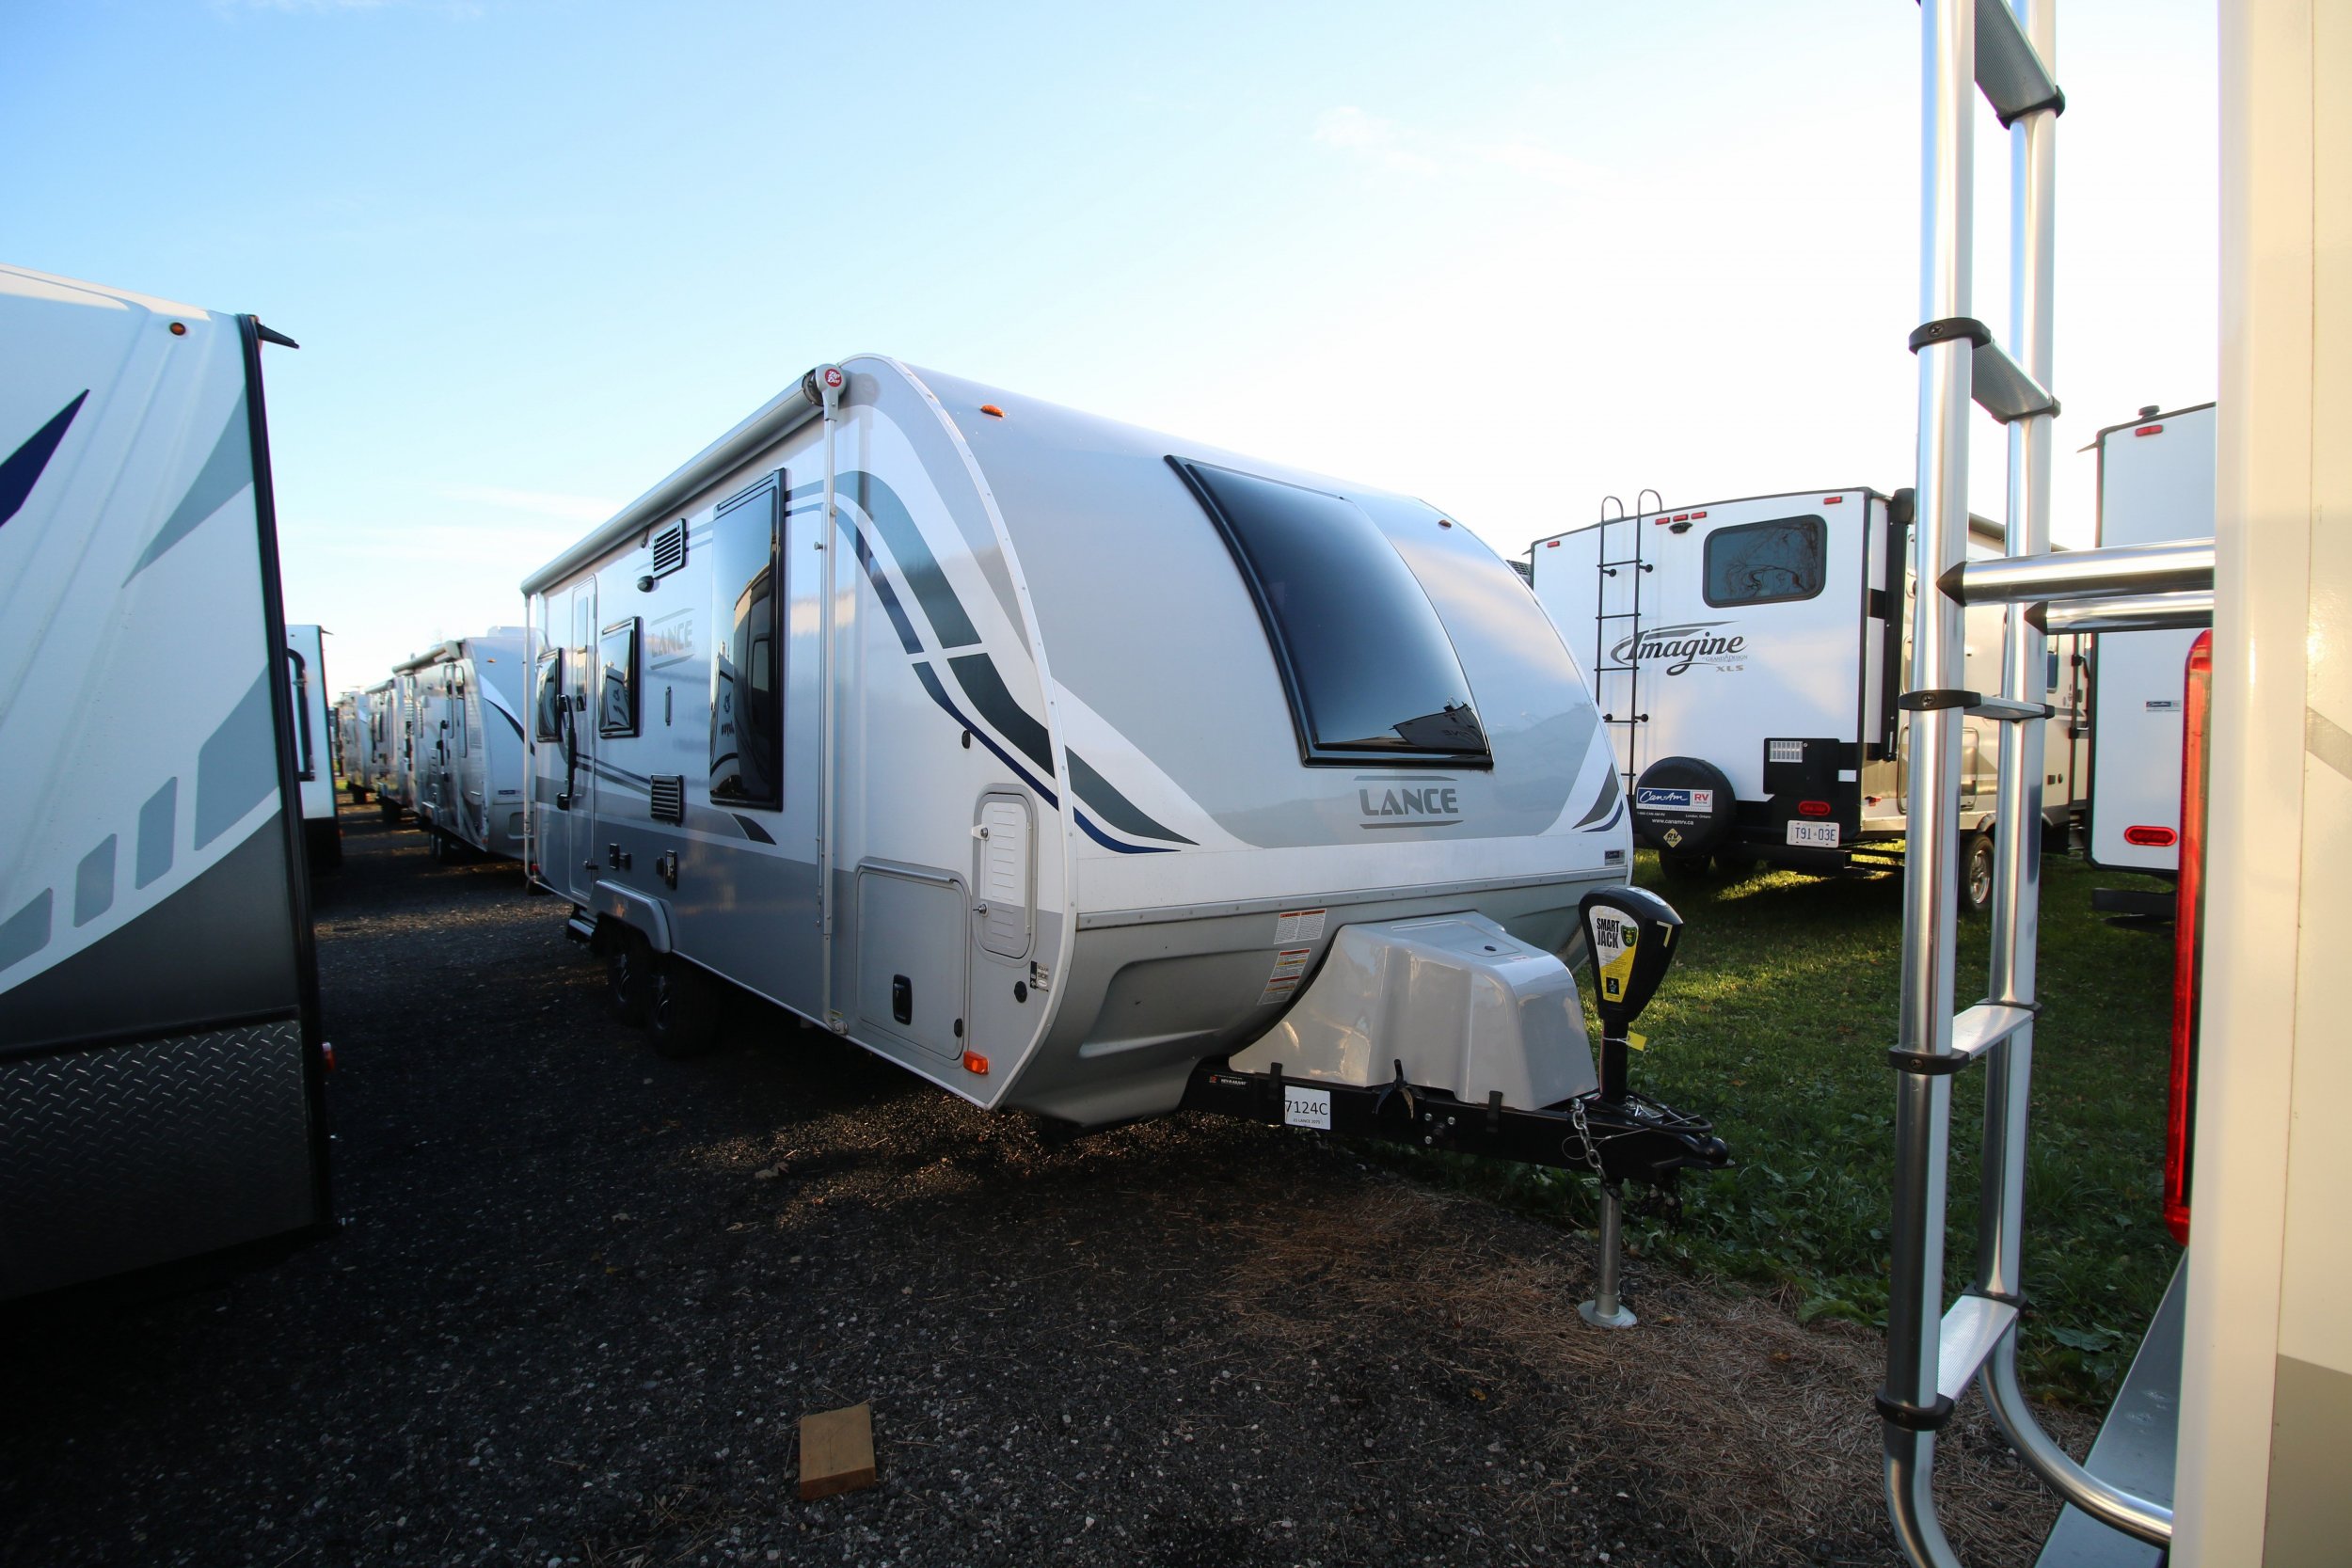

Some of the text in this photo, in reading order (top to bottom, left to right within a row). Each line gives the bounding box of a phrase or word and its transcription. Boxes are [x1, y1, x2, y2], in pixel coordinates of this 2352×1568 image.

[651, 620, 692, 657] LANCE
[1614, 628, 1749, 675] Imagine
[1715, 664, 1744, 673] XLS
[1359, 788, 1458, 816] LANCE
[1694, 793, 1709, 801] RV
[1651, 817, 1693, 826] www.canamrv.ca
[1795, 827, 1836, 842] T91 03E
[1597, 917, 1620, 933] SMART
[1597, 930, 1619, 949] JACK
[1285, 1100, 1328, 1116] 7124C
